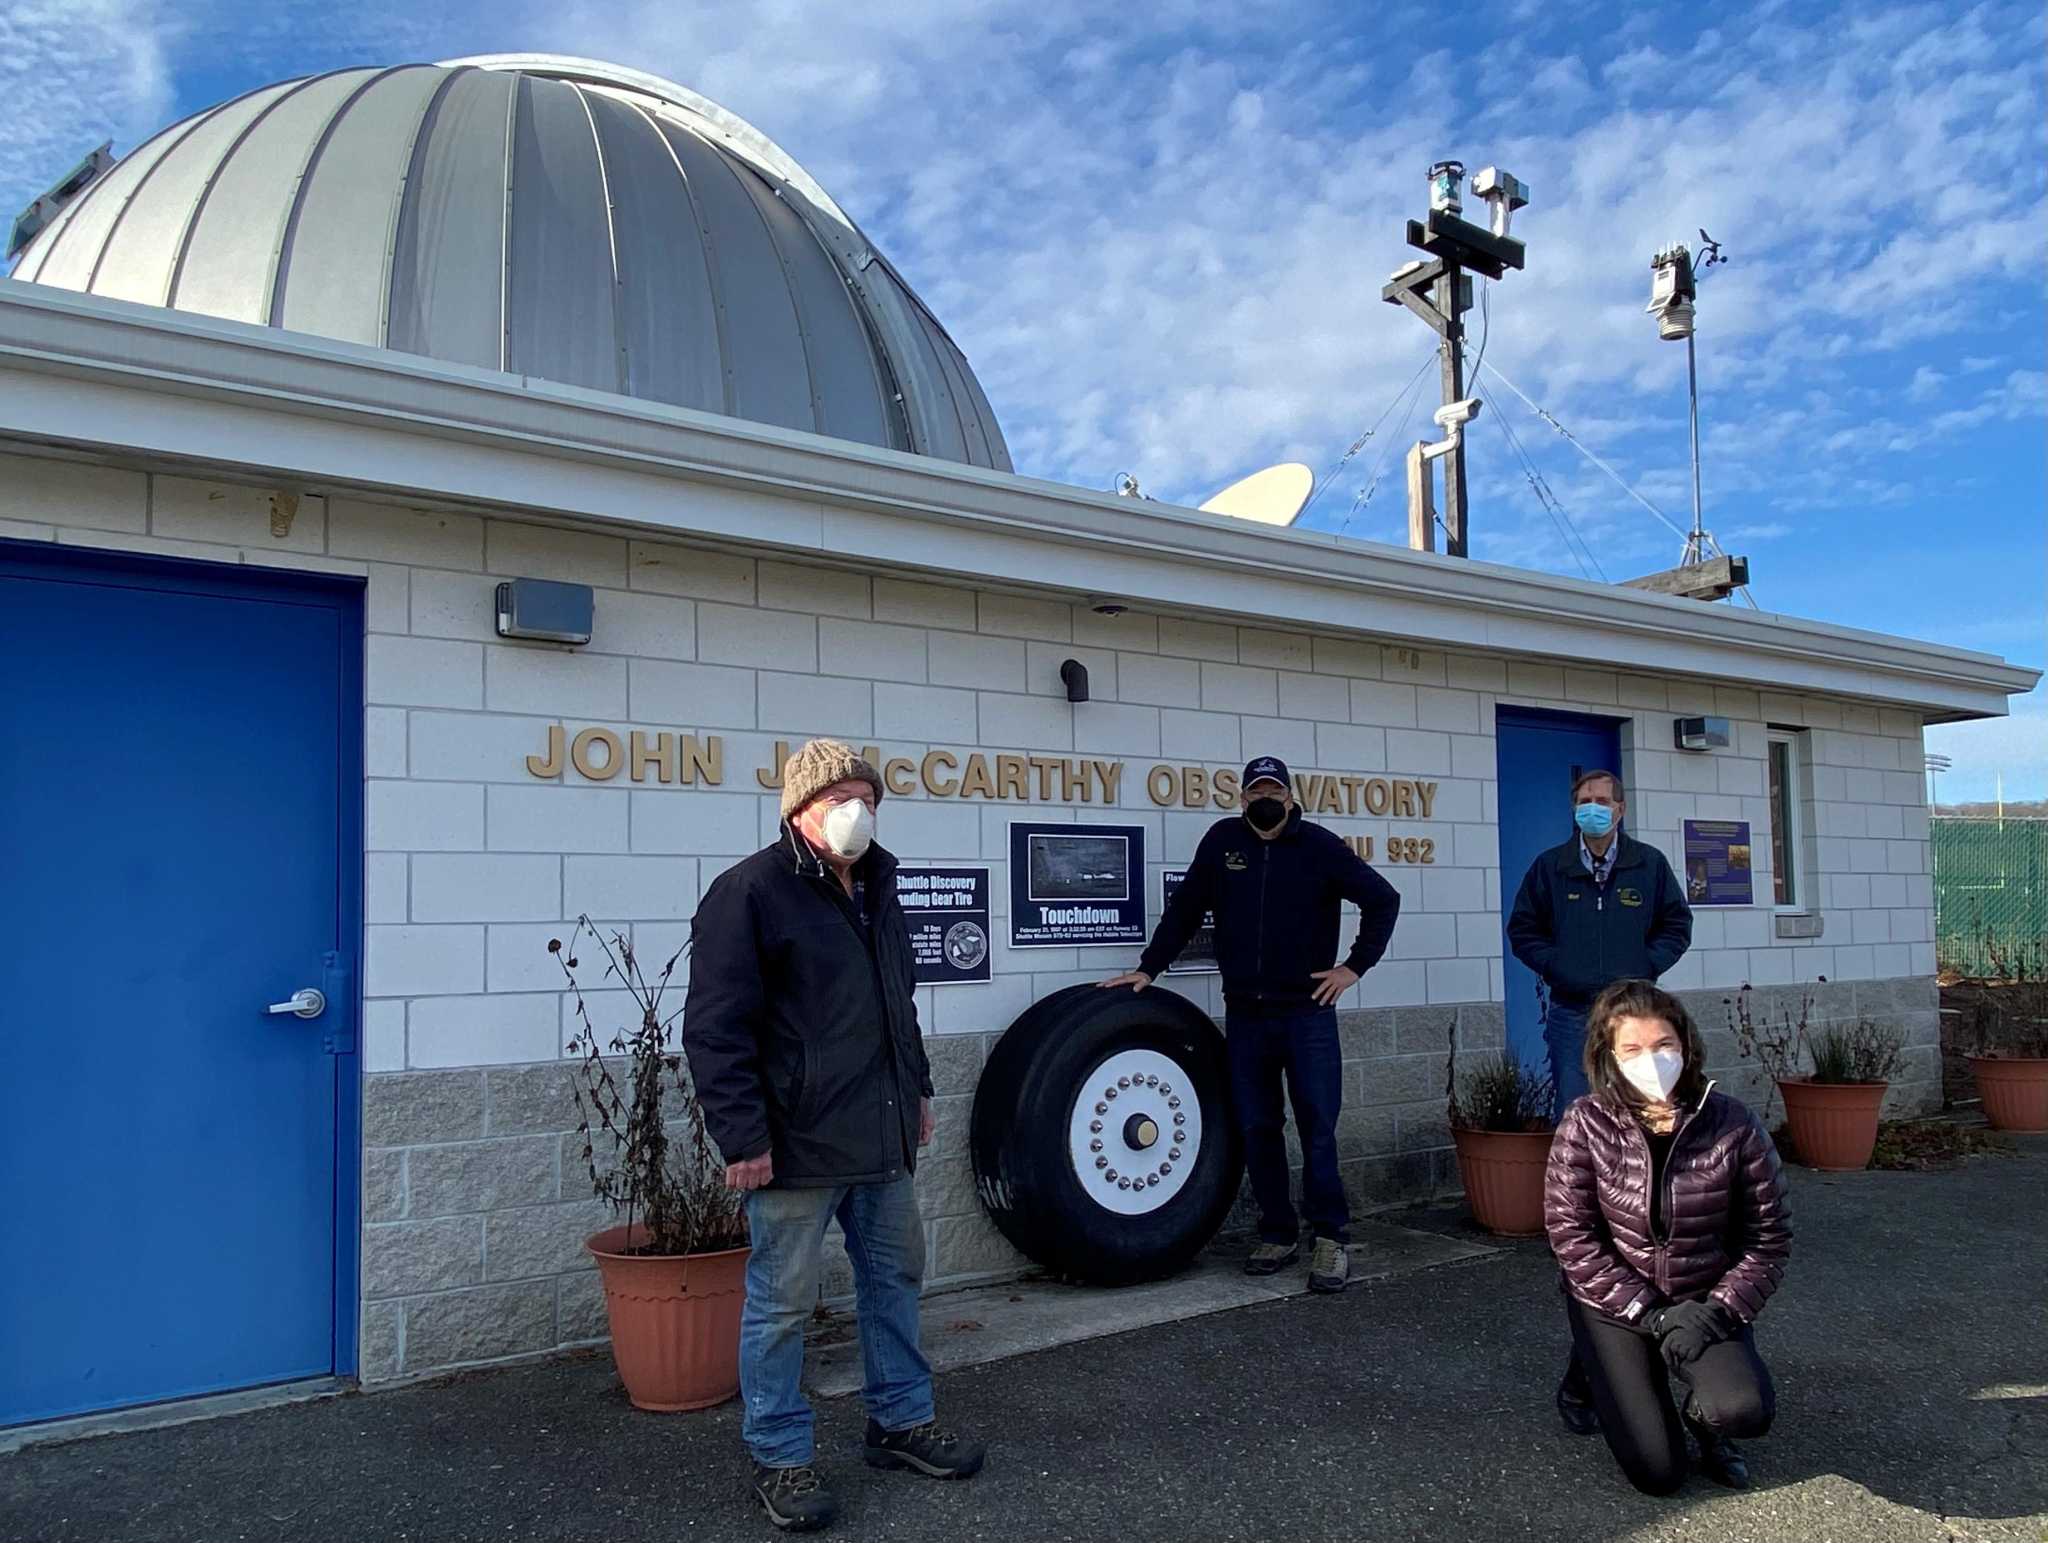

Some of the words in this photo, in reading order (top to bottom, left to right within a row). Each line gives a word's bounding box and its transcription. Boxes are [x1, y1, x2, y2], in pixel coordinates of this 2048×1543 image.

[526, 725, 723, 785] JOHN
[862, 746, 1123, 803] cCARTHY
[1148, 765, 1437, 817] OBSVATORY
[1387, 836, 1435, 864] 932
[896, 875, 929, 890] Shuttle
[930, 875, 976, 890] Discovery
[897, 892, 930, 907] anding
[931, 892, 953, 906] Gear
[953, 891, 973, 906] Tire
[1040, 906, 1119, 925] Touchdown
